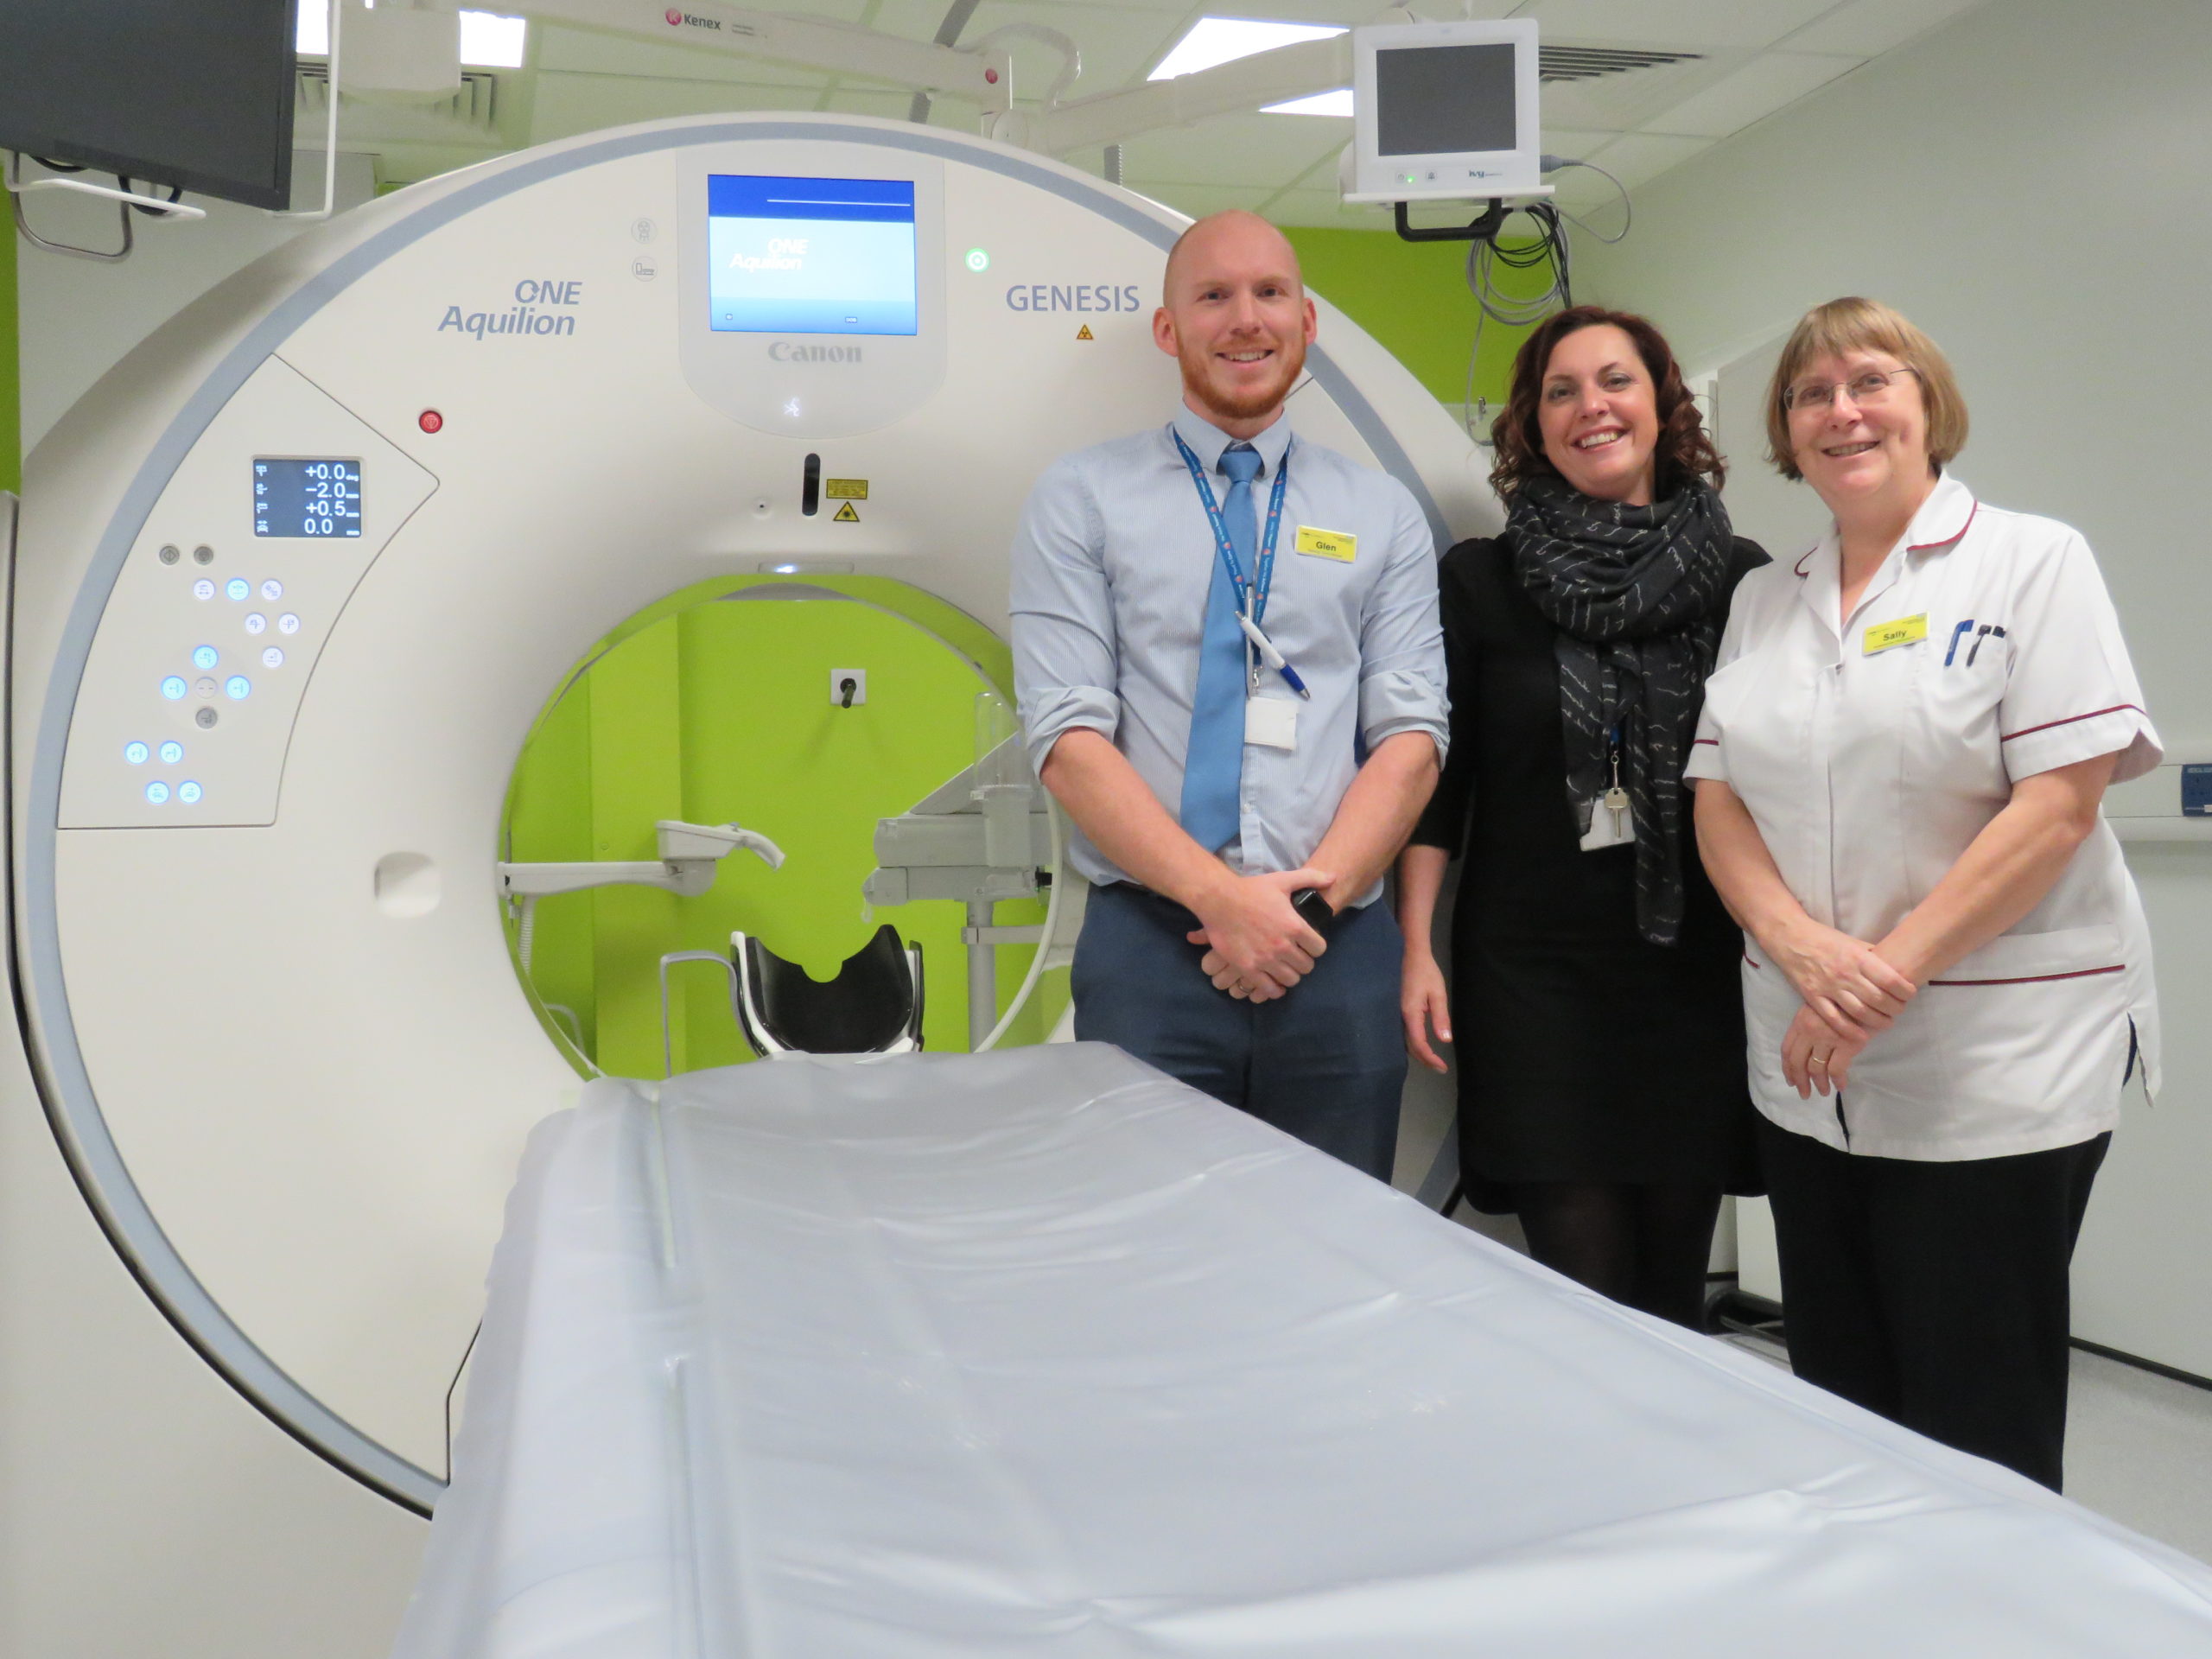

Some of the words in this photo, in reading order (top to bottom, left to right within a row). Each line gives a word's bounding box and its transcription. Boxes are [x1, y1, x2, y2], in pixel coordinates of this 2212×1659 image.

[683, 13, 721, 30] Kenex
[728, 252, 802, 273] Aquilion
[514, 279, 582, 305] ONE
[1006, 284, 1141, 312] GENESIS
[436, 306, 575, 340] Aquilion
[767, 341, 862, 363] Canon
[304, 518, 333, 535] 0.0
[1316, 541, 1337, 551] Glen
[1883, 631, 1907, 641] Sally
